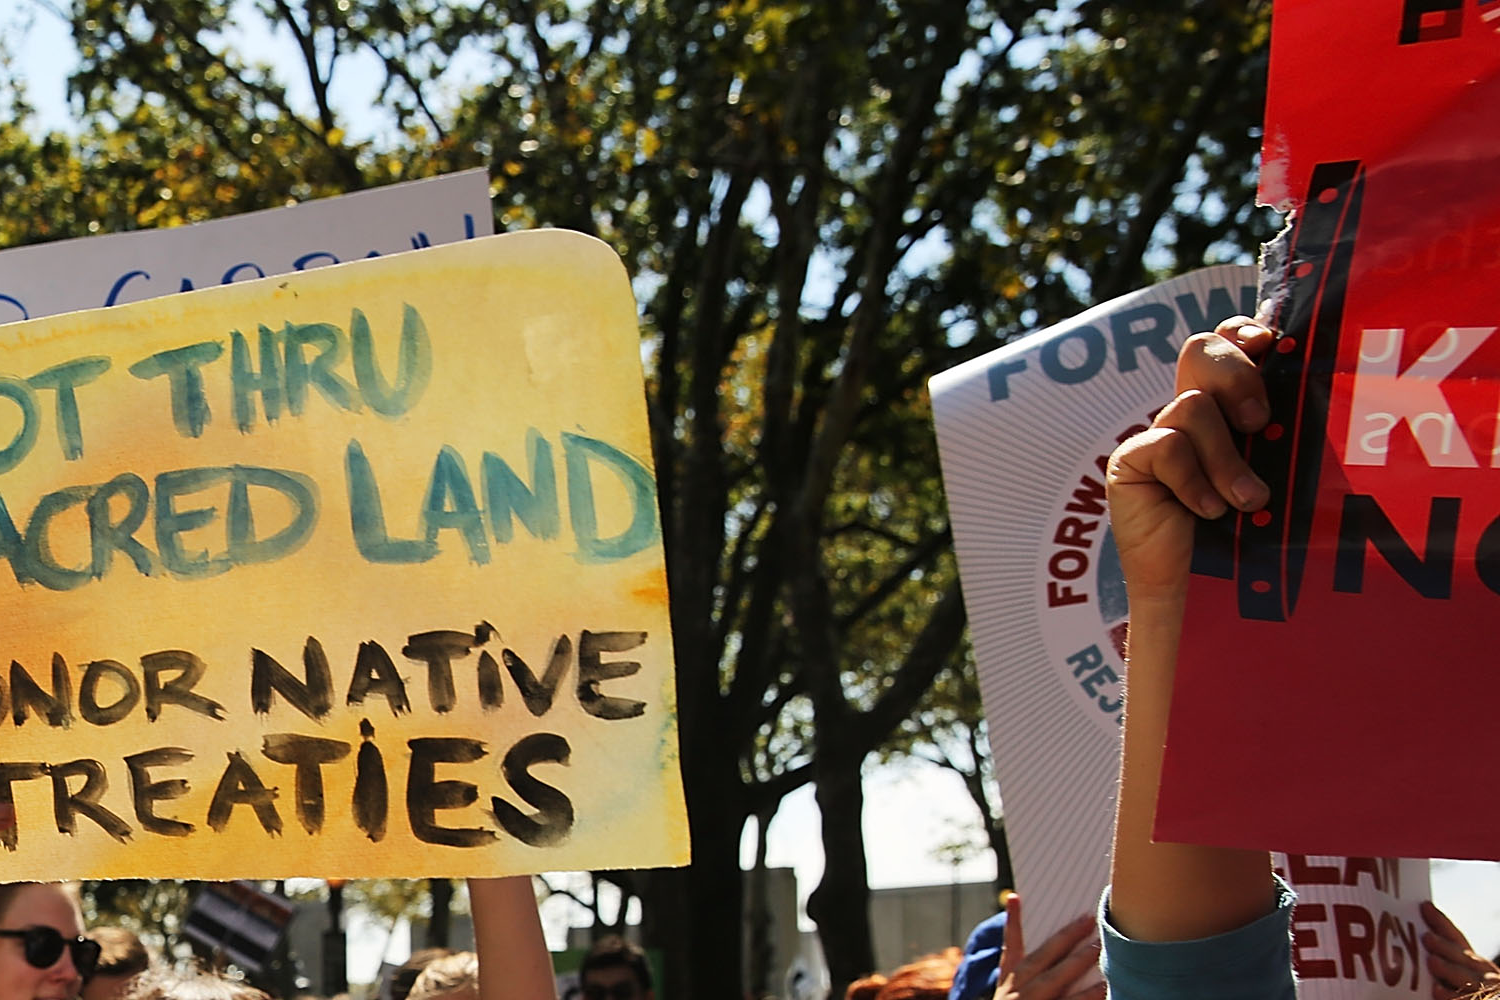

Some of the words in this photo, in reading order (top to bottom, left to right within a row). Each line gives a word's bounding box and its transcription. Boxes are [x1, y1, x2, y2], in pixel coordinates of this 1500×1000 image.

[129, 300, 433, 439] THRU
[987, 285, 1259, 402] FORW
[344, 424, 663, 566] LAND
